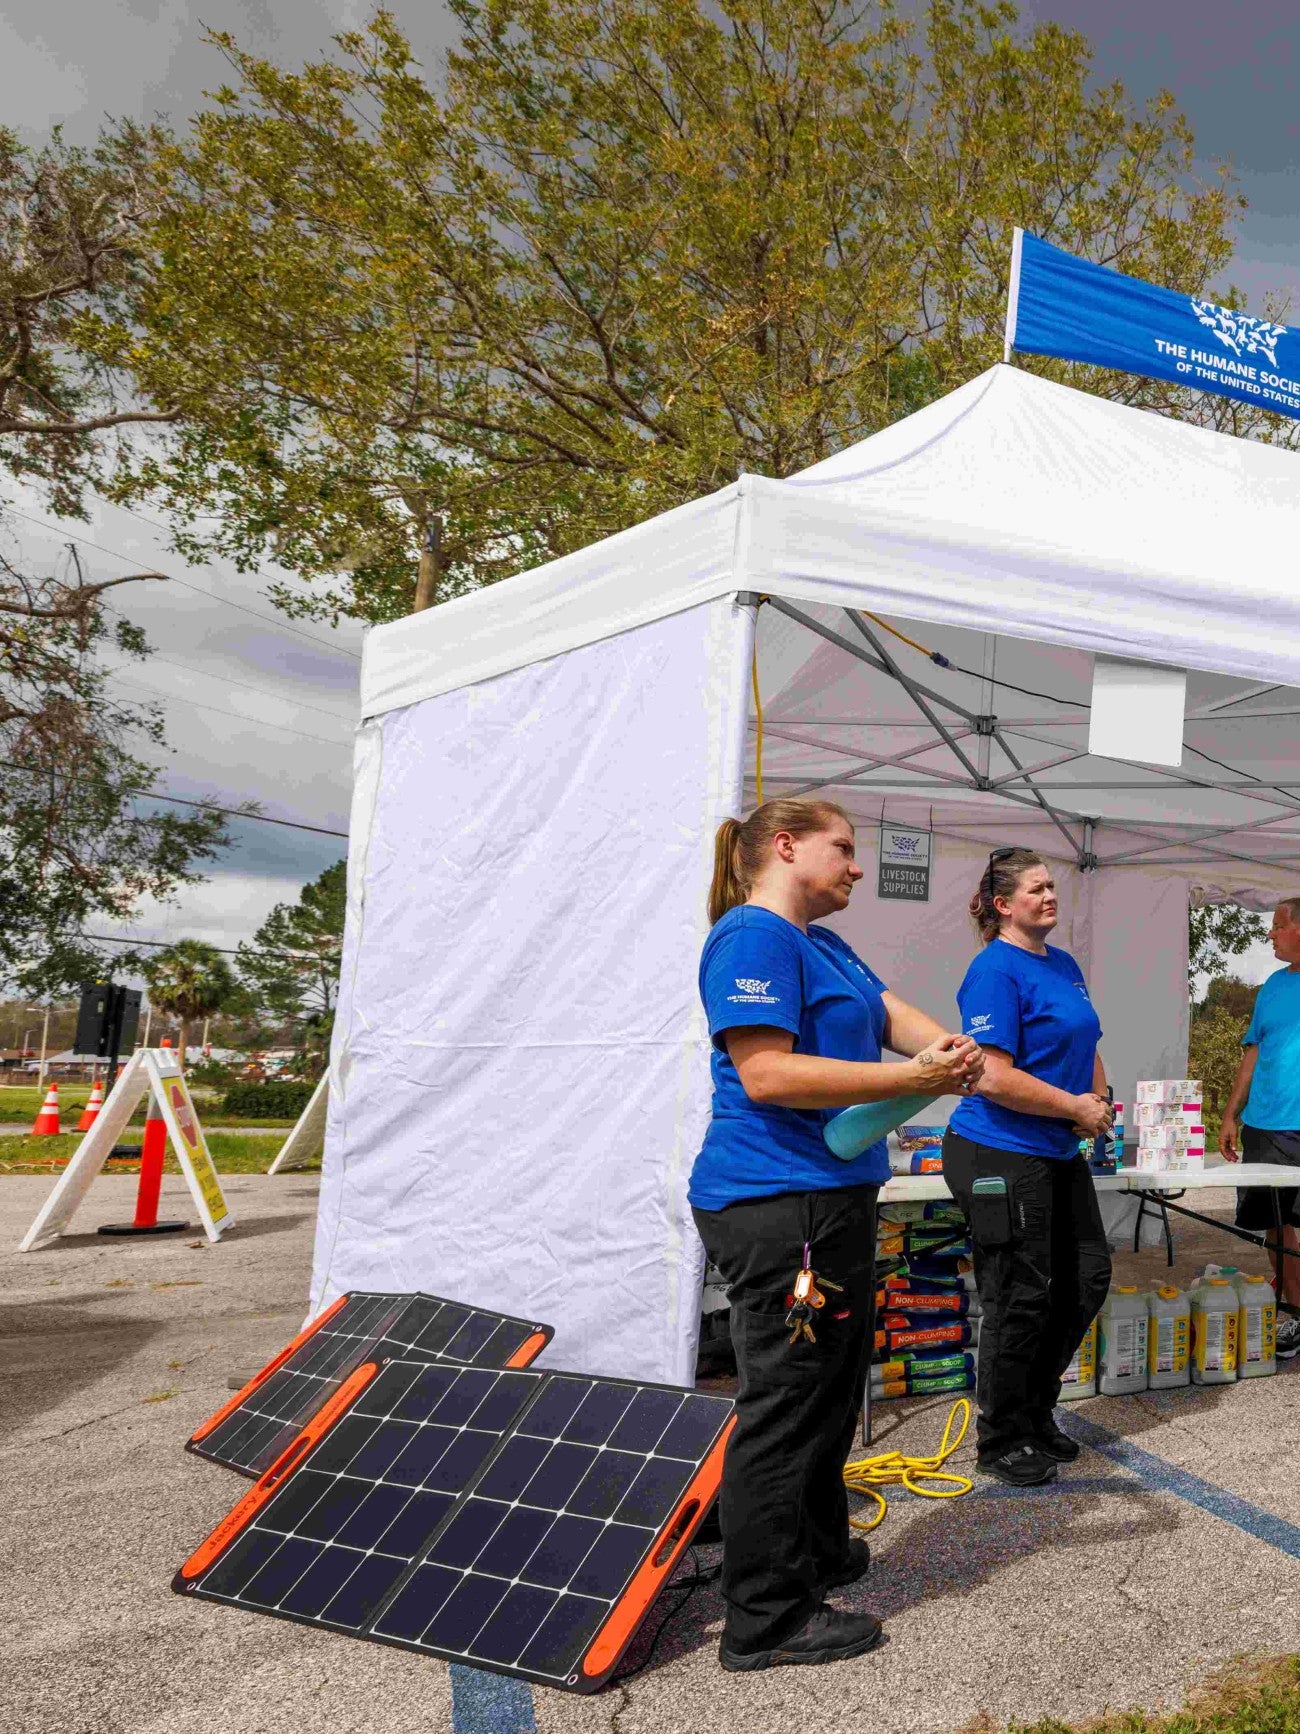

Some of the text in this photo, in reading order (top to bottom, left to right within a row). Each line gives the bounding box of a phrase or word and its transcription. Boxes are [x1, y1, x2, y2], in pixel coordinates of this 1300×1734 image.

[1154, 338, 1188, 360] THE
[1190, 349, 1257, 380] HUMANE
[1176, 361, 1300, 409] OF THE UNITED STATES
[881, 869, 926, 883] LIVESTOCK
[883, 881, 925, 895] SUPPLIES
[895, 1296, 954, 1306] NON-CLUMPING
[897, 1330, 956, 1344] NON-CLUMPING
[914, 1362, 935, 1371] CLUMP
[916, 1381, 937, 1389] CLUMP
[208, 1495, 258, 1551] Jackery
